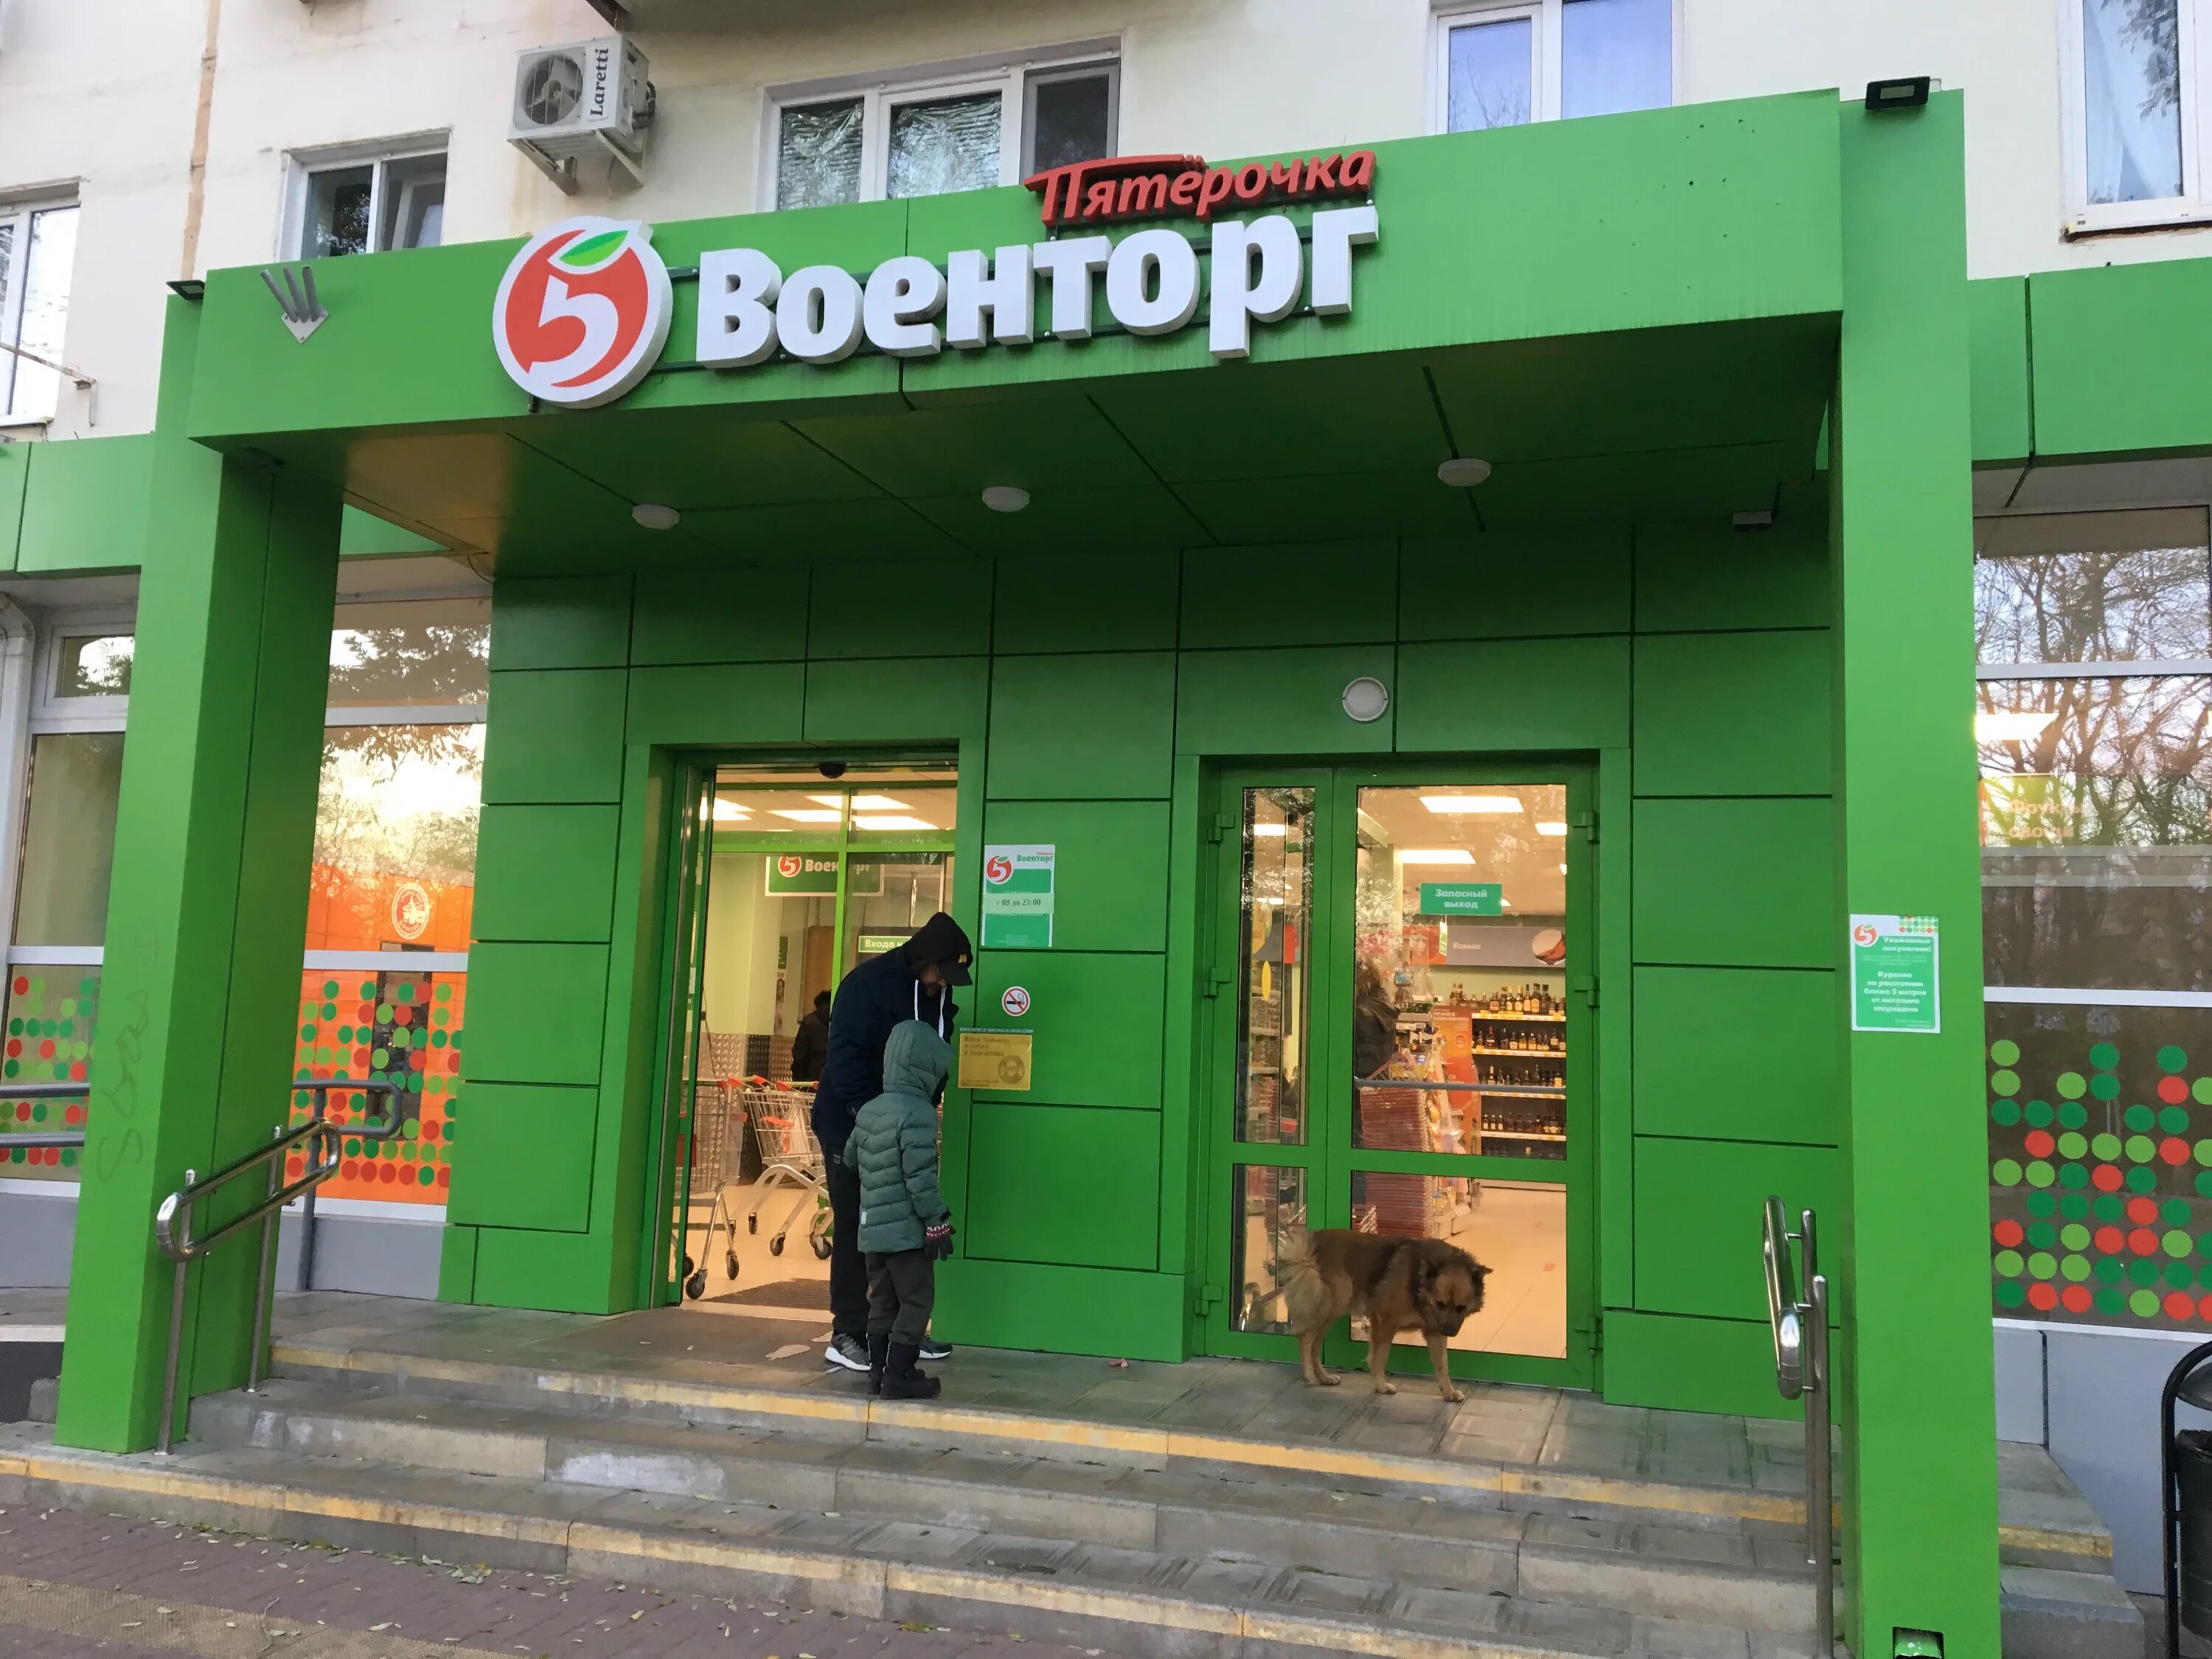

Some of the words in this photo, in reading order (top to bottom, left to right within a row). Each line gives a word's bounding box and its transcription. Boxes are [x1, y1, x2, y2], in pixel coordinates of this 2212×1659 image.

[590, 46, 609, 116] Laretti
[1024, 150, 1377, 224] Пятерочка
[696, 206, 1378, 366] Военторг
[1016, 855, 1054, 863] Военторг
[1435, 888, 1488, 897] Запасный
[1444, 901, 1478, 909] выход
[864, 939, 894, 948] Входа
